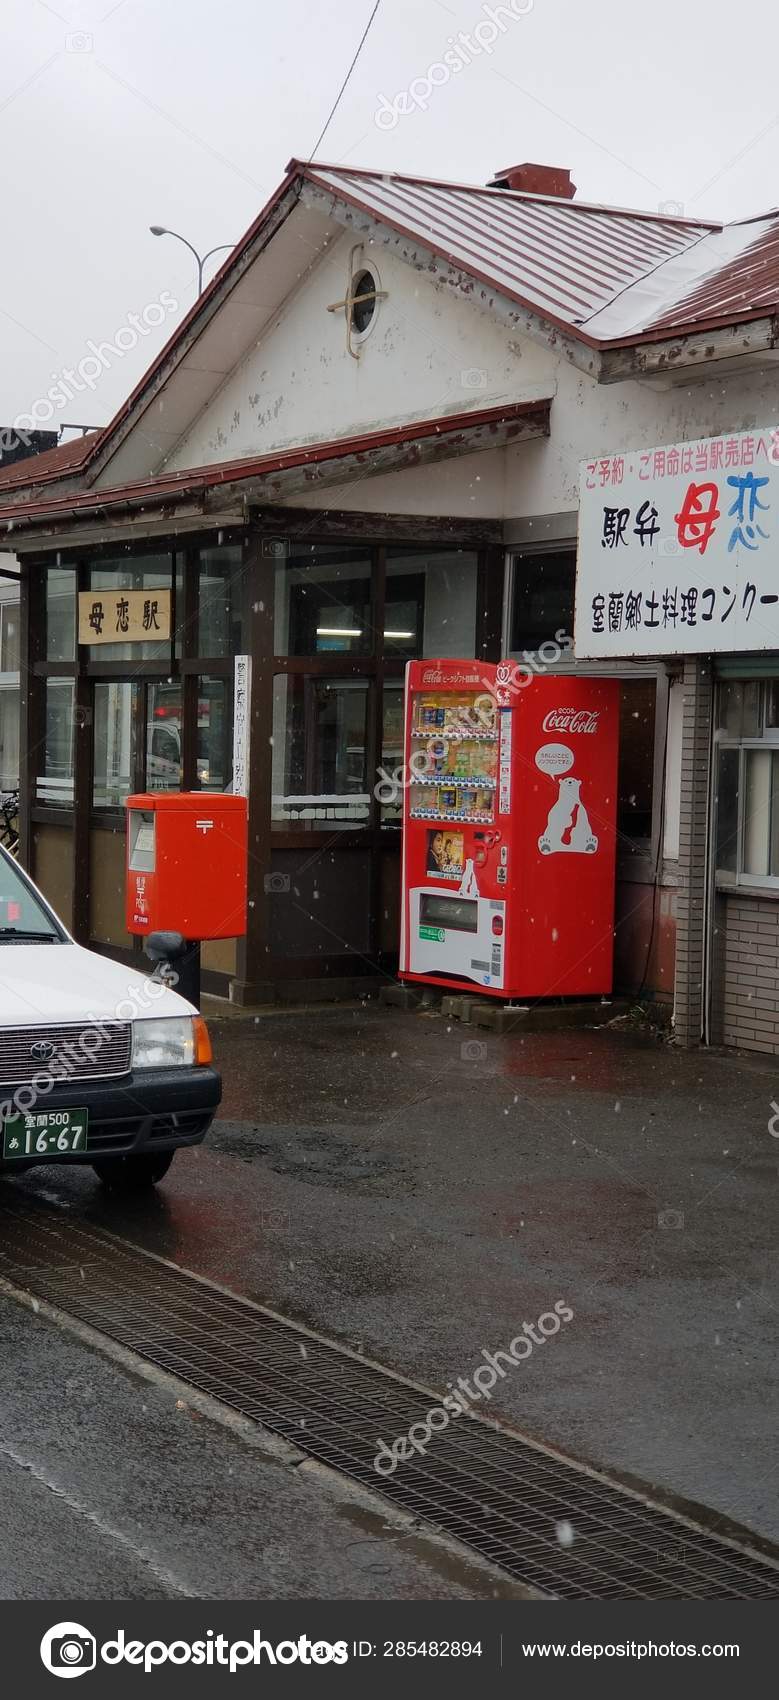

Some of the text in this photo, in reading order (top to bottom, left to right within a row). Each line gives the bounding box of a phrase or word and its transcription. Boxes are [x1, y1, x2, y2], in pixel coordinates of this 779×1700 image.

[585, 430, 779, 489] ご予約・ご用命は当駅売店へ
[601, 471, 770, 555] 駅弁 母恋
[88, 597, 161, 635] 母恋駅
[542, 710, 600, 734] Coca-Cola
[24, 1112, 70, 1129] 室蘭500
[8, 1125, 83, 1154] あ 16-67
